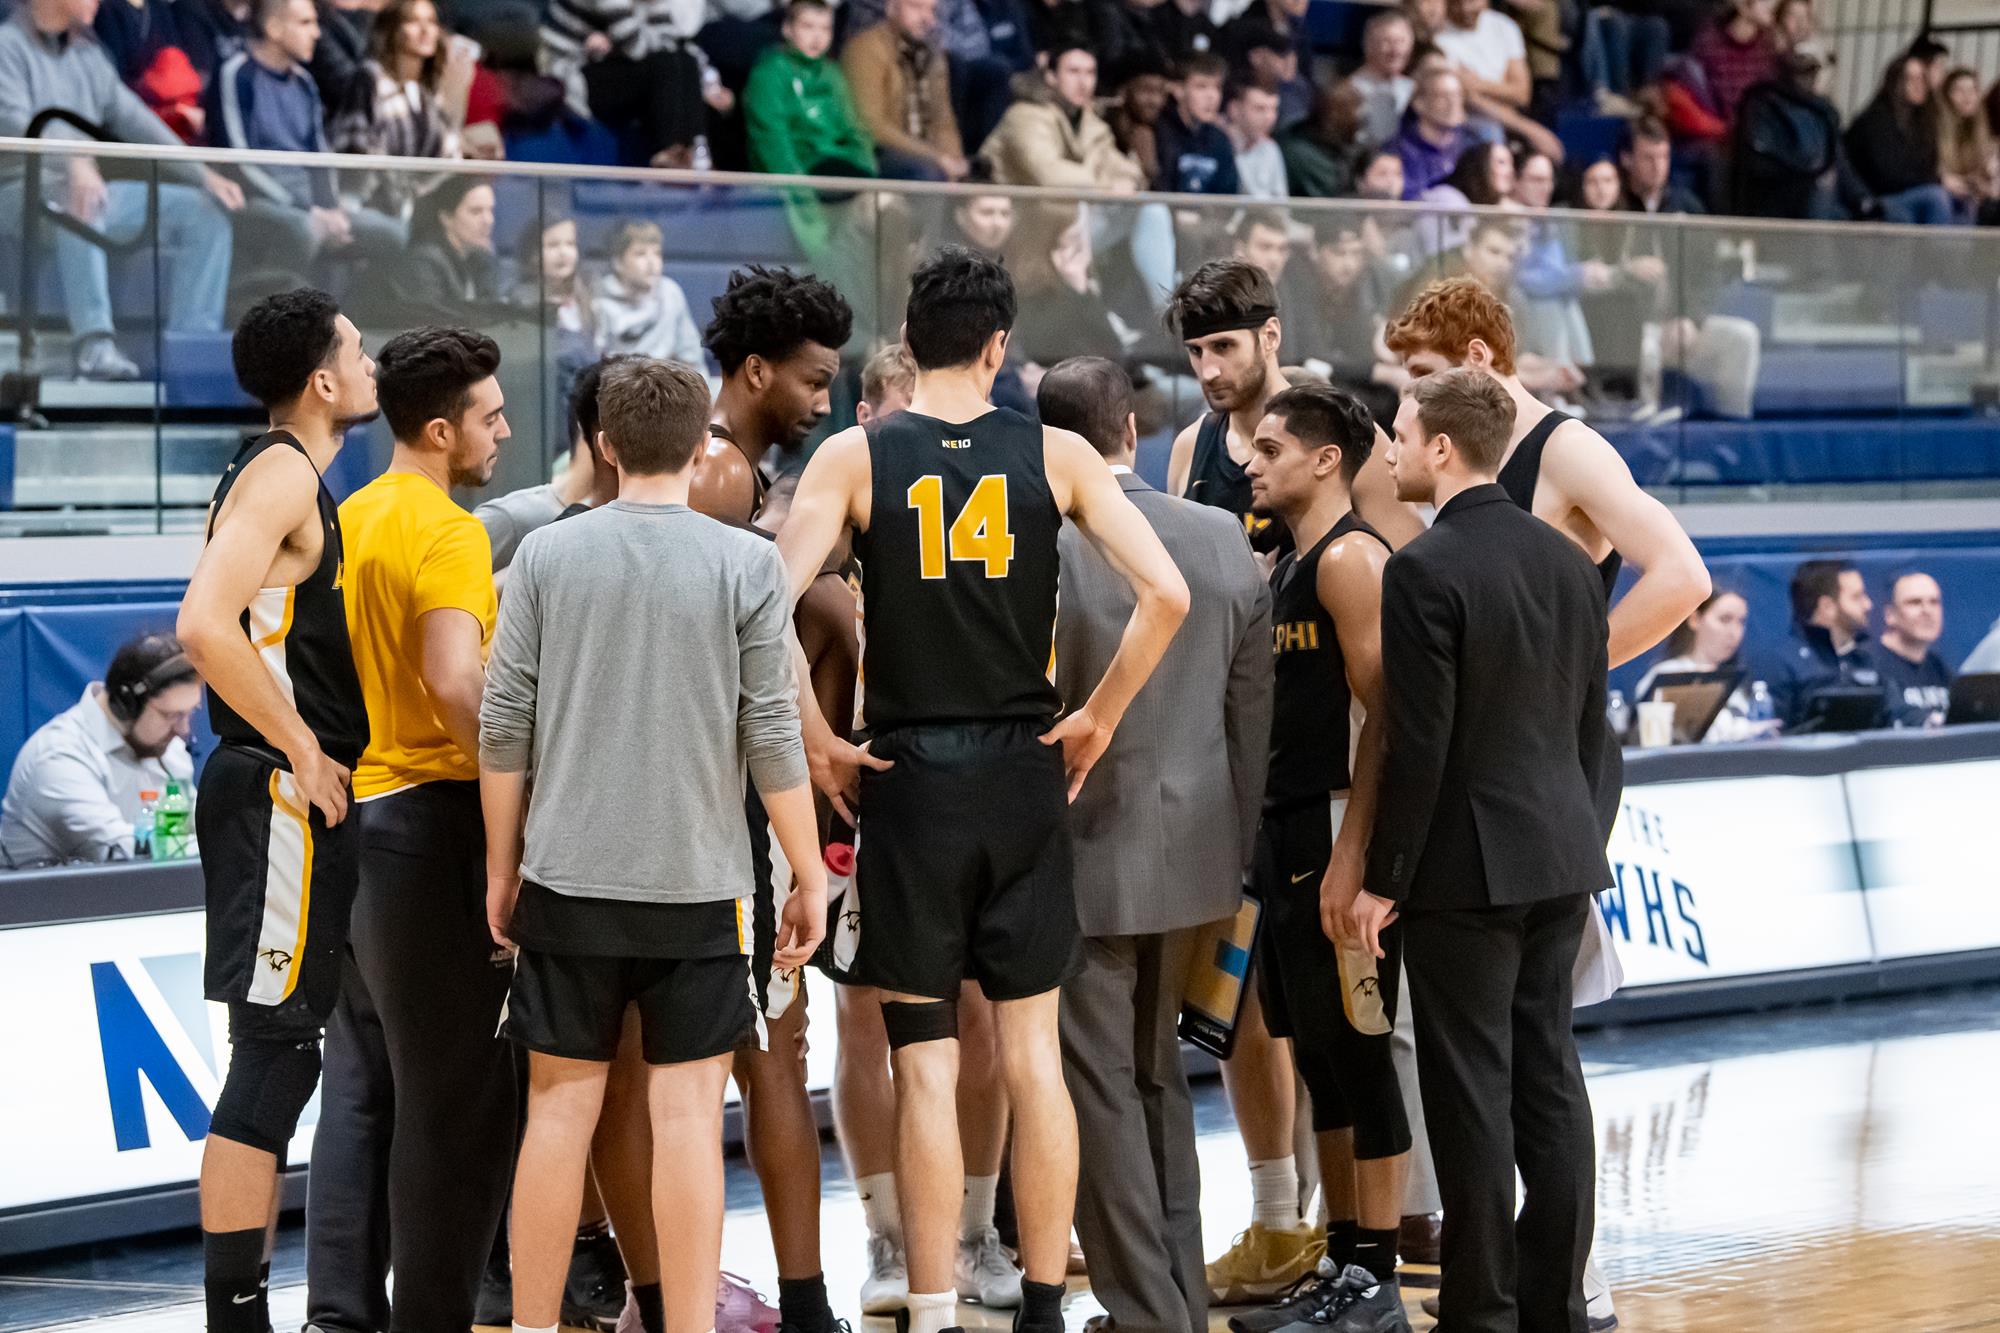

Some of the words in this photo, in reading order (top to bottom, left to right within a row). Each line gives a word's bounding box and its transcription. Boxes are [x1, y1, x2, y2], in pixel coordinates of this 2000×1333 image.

[941, 438, 971, 449] NE10
[907, 473, 1015, 579] 14
[1272, 621, 1319, 655] PHI
